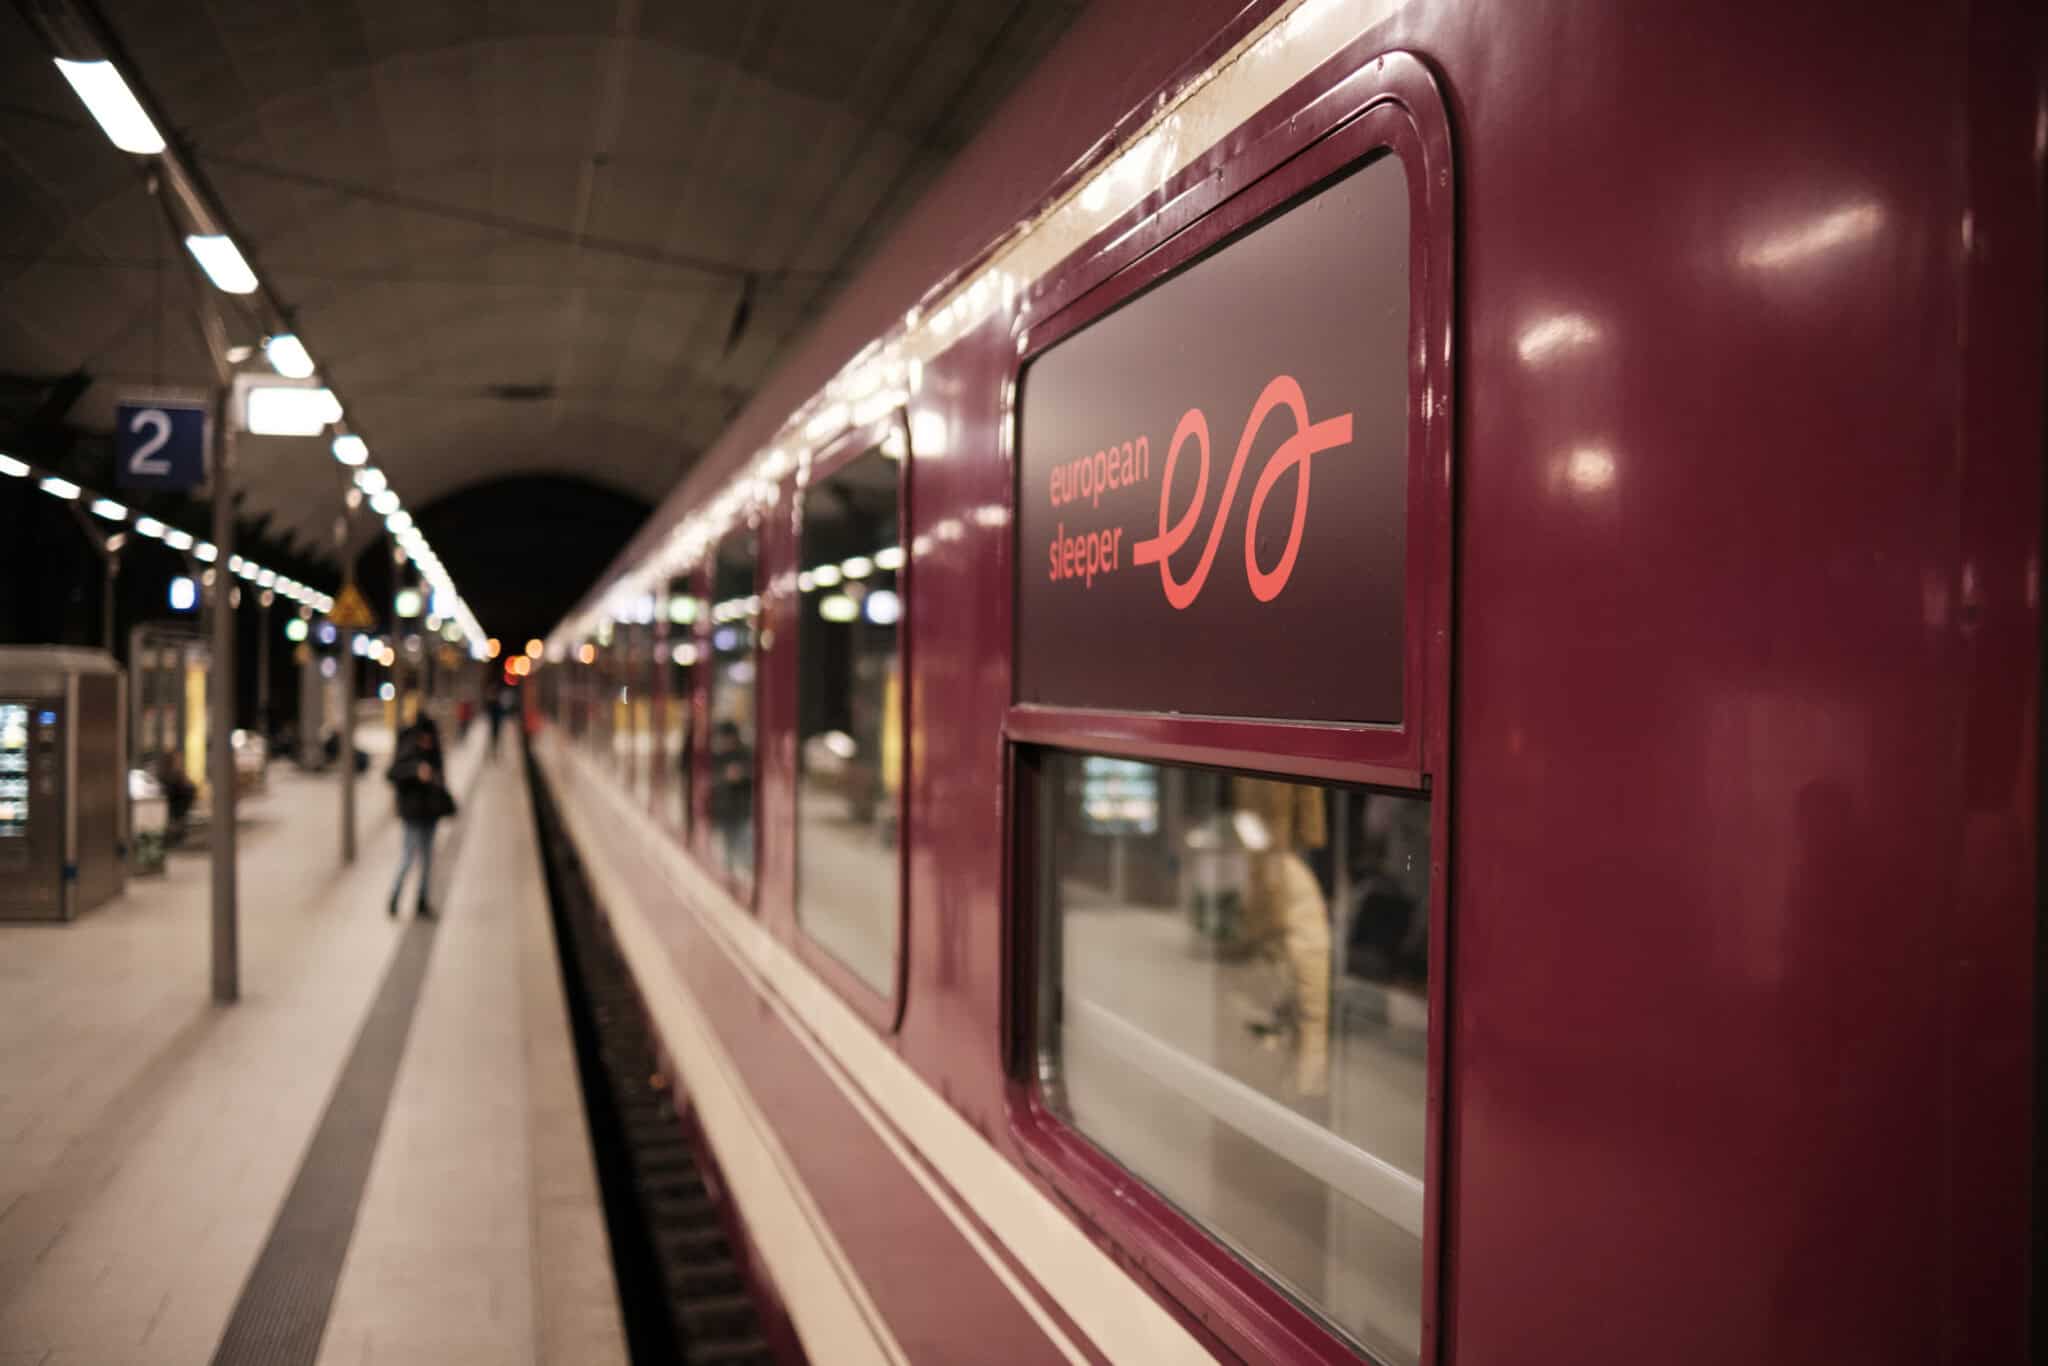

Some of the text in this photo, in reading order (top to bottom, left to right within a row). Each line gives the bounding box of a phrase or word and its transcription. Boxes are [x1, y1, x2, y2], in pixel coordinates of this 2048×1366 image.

[130, 409, 171, 475] 2
[1050, 435, 1149, 508] european
[1049, 523, 1123, 589] sleeper
